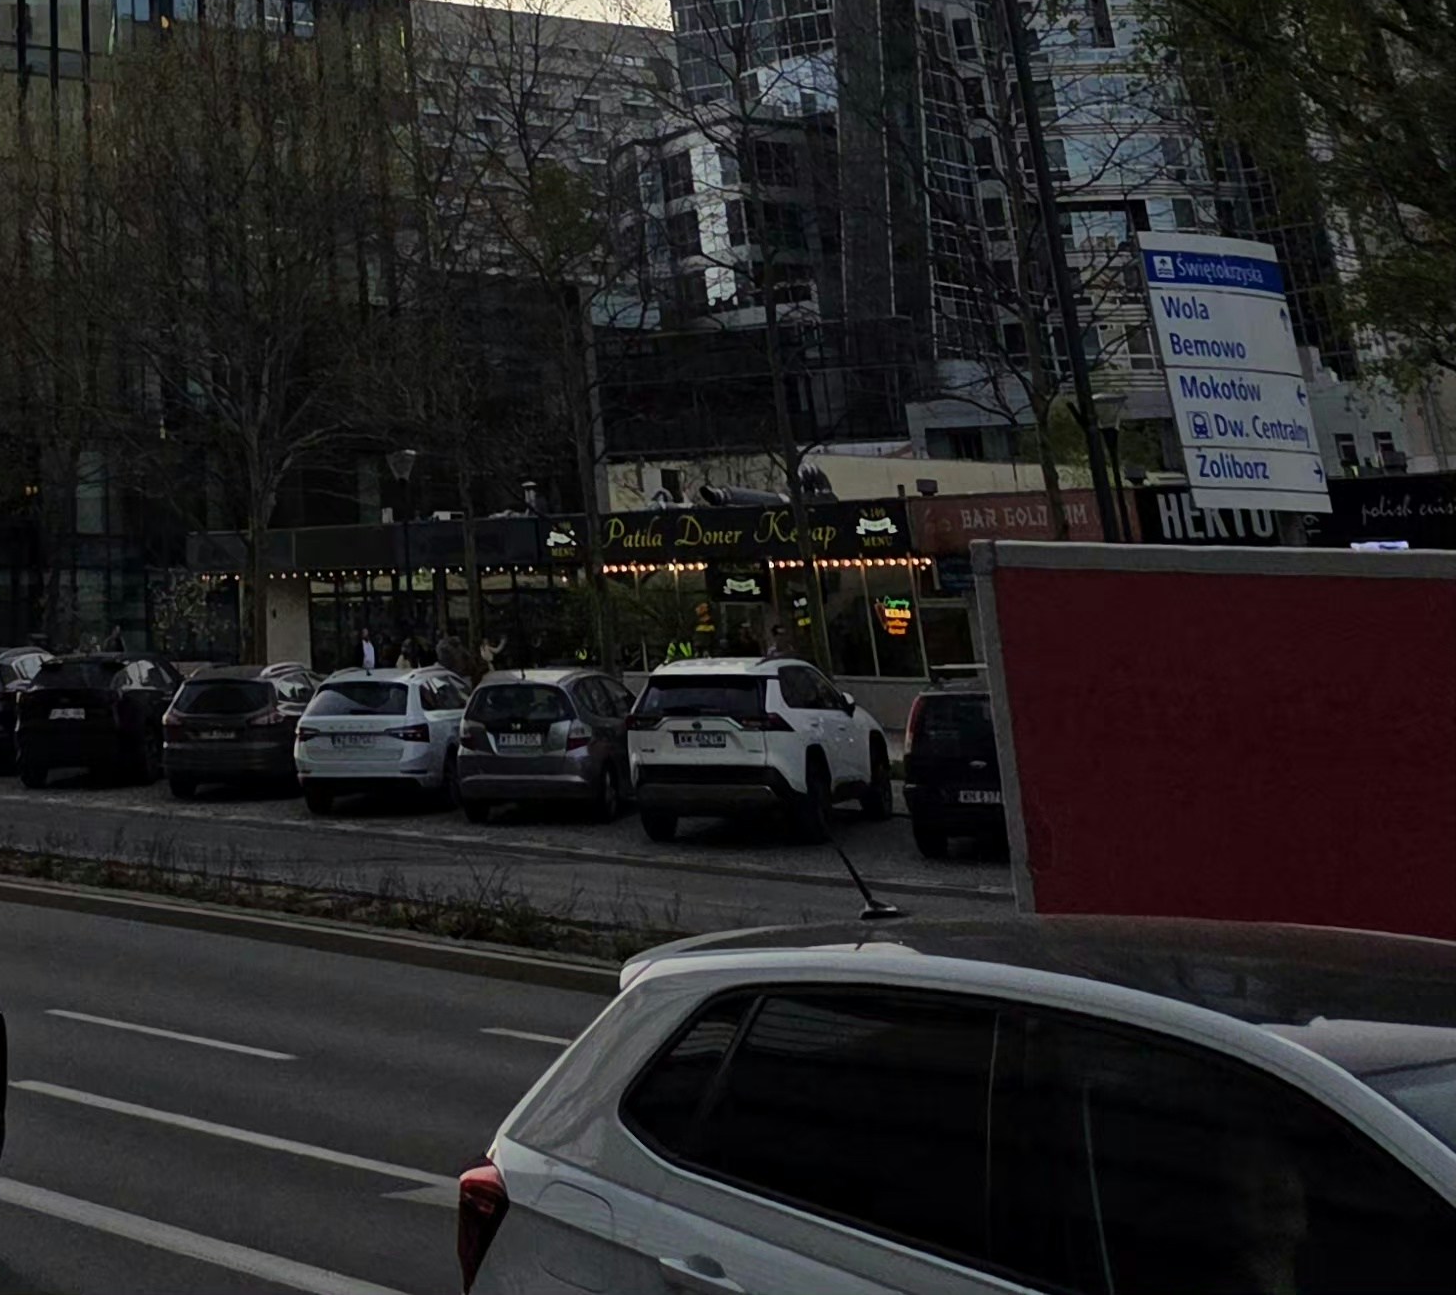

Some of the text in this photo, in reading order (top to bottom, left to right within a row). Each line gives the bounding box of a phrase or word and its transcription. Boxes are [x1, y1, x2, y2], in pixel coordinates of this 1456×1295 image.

[1175, 253, 1264, 286] Świętokrzyska
[1161, 296, 1210, 320] Wola
[1169, 332, 1246, 359] Bemowo
[1179, 374, 1261, 401] Mokotów
[1214, 413, 1310, 449] Dw. Centralny
[1196, 446, 1270, 479] Żoliborz
[960, 507, 997, 530] BAR
[1004, 504, 1048, 528] GOLD
[1361, 492, 1413, 527] polish
[603, 510, 836, 551] Patila Doner Keap
